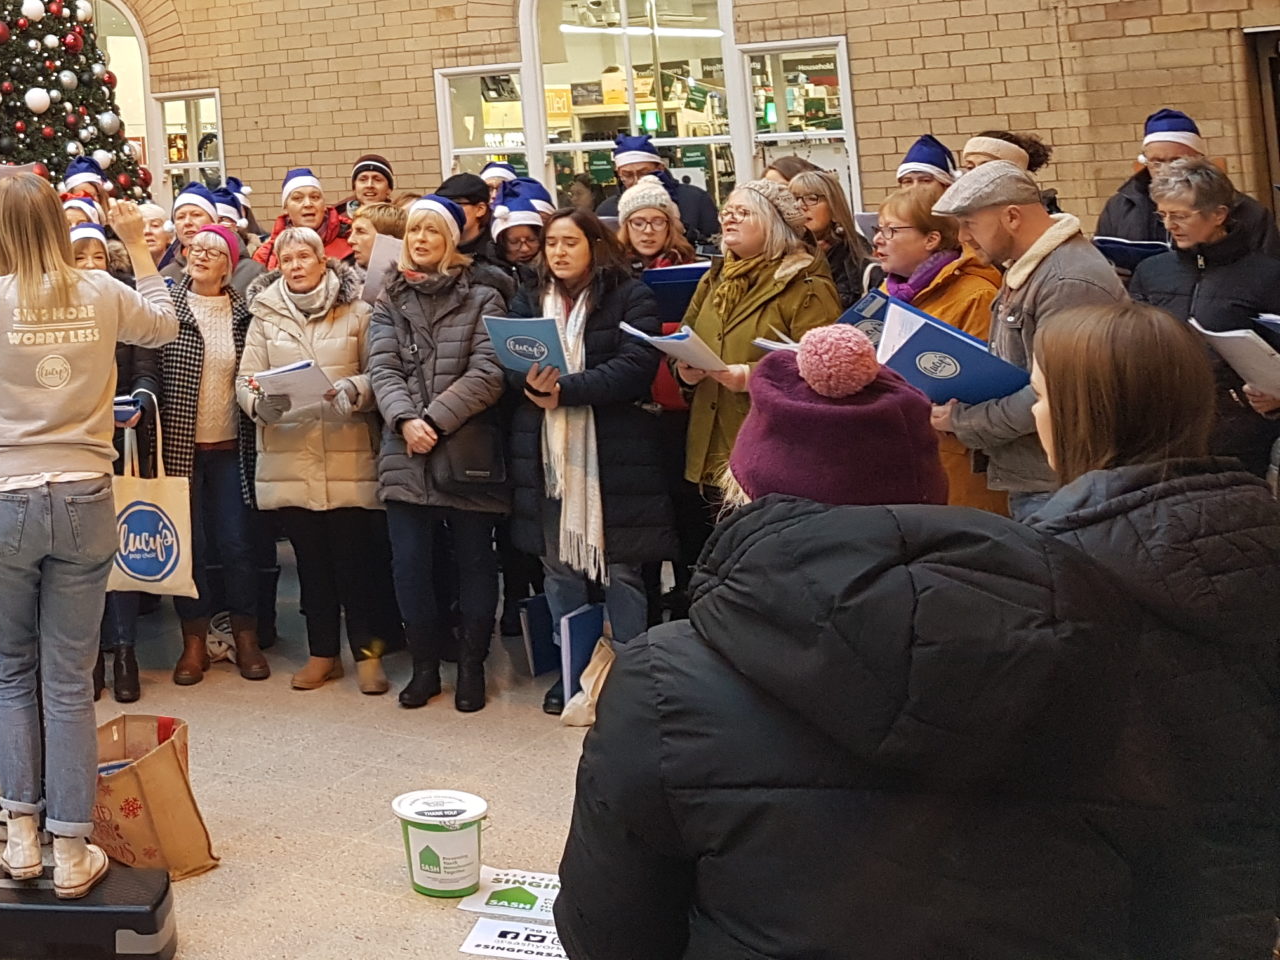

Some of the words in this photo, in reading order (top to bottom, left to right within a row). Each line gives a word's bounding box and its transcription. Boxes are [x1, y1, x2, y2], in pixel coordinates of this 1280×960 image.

[797, 62, 835, 71] Household
[6, 331, 66, 345] WORRY
[69, 328, 100, 343] LESS
[509, 340, 545, 358] lucy's
[120, 521, 174, 562] lucy's
[421, 863, 440, 873] SASH
[491, 877, 561, 890] SINGIN
[487, 899, 532, 910] SASH
[524, 926, 542, 934] Tag
